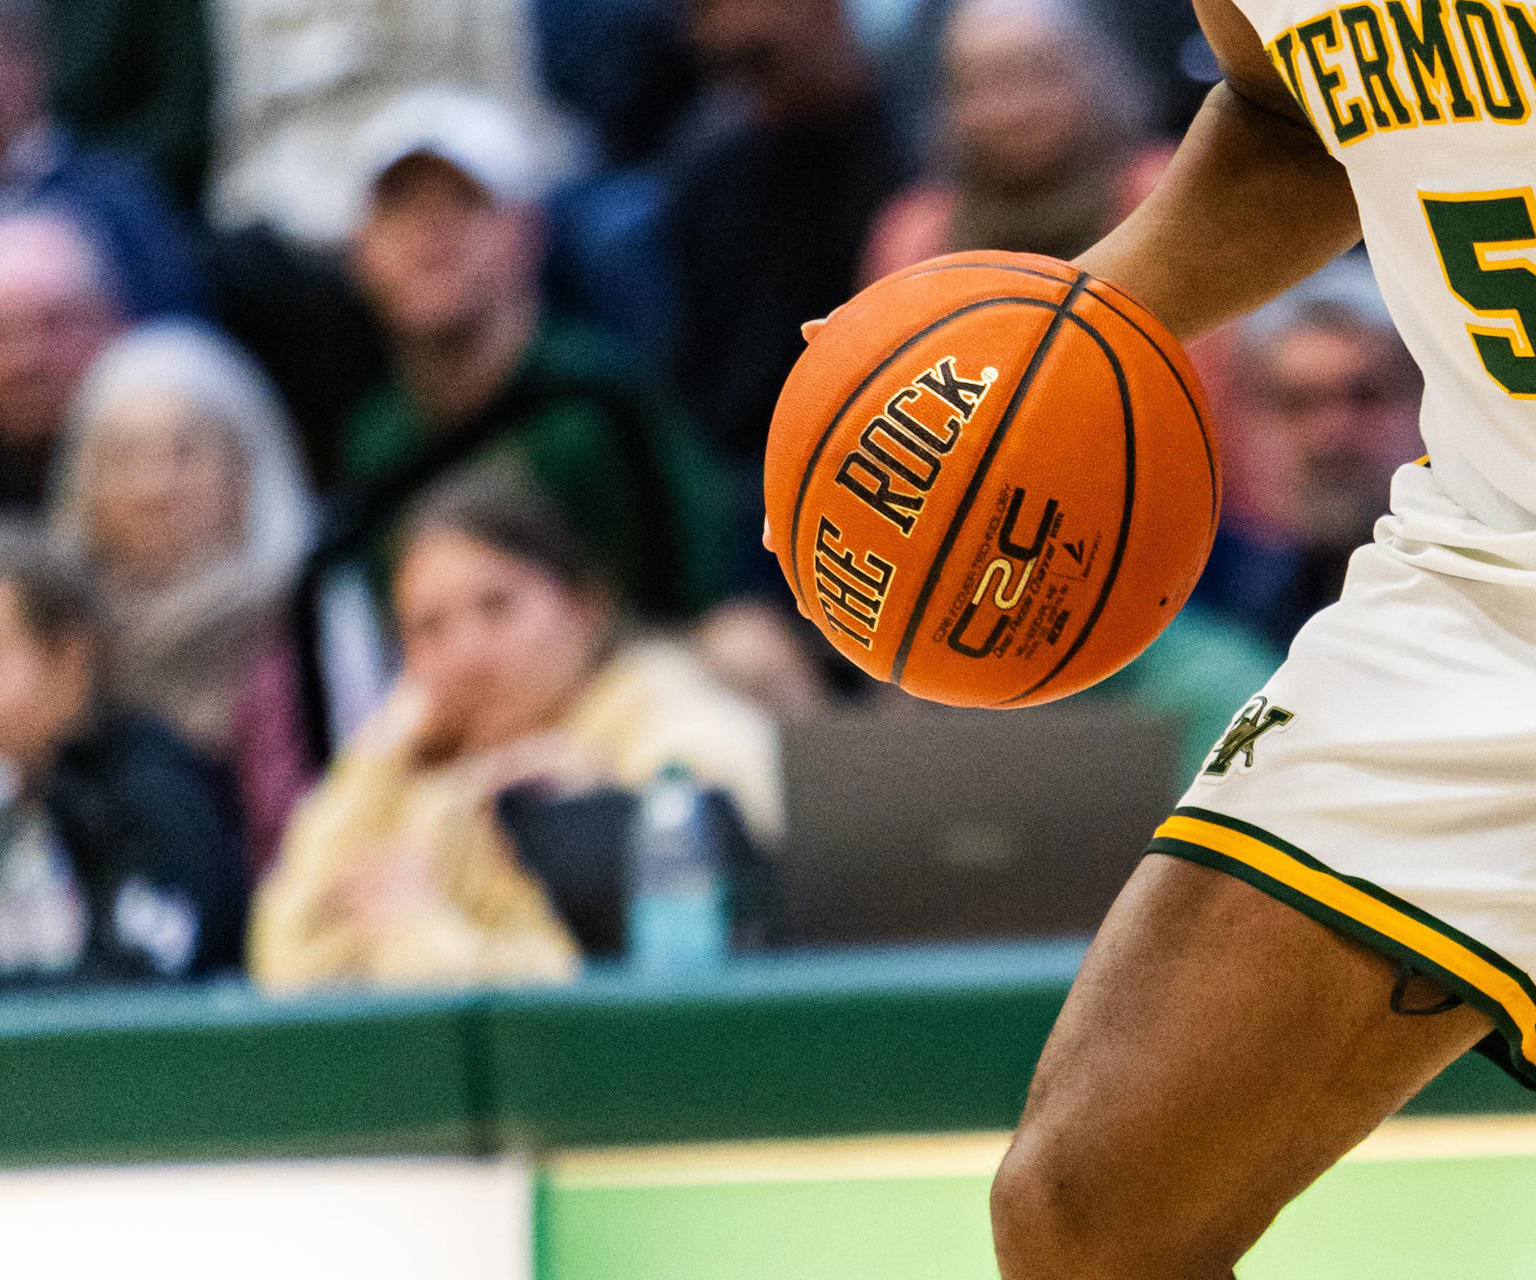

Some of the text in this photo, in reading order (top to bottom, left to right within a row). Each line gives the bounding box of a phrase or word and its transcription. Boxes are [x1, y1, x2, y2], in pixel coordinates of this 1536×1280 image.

[814, 356, 987, 650] THE ROCK
[948, 487, 1058, 659] C2C
